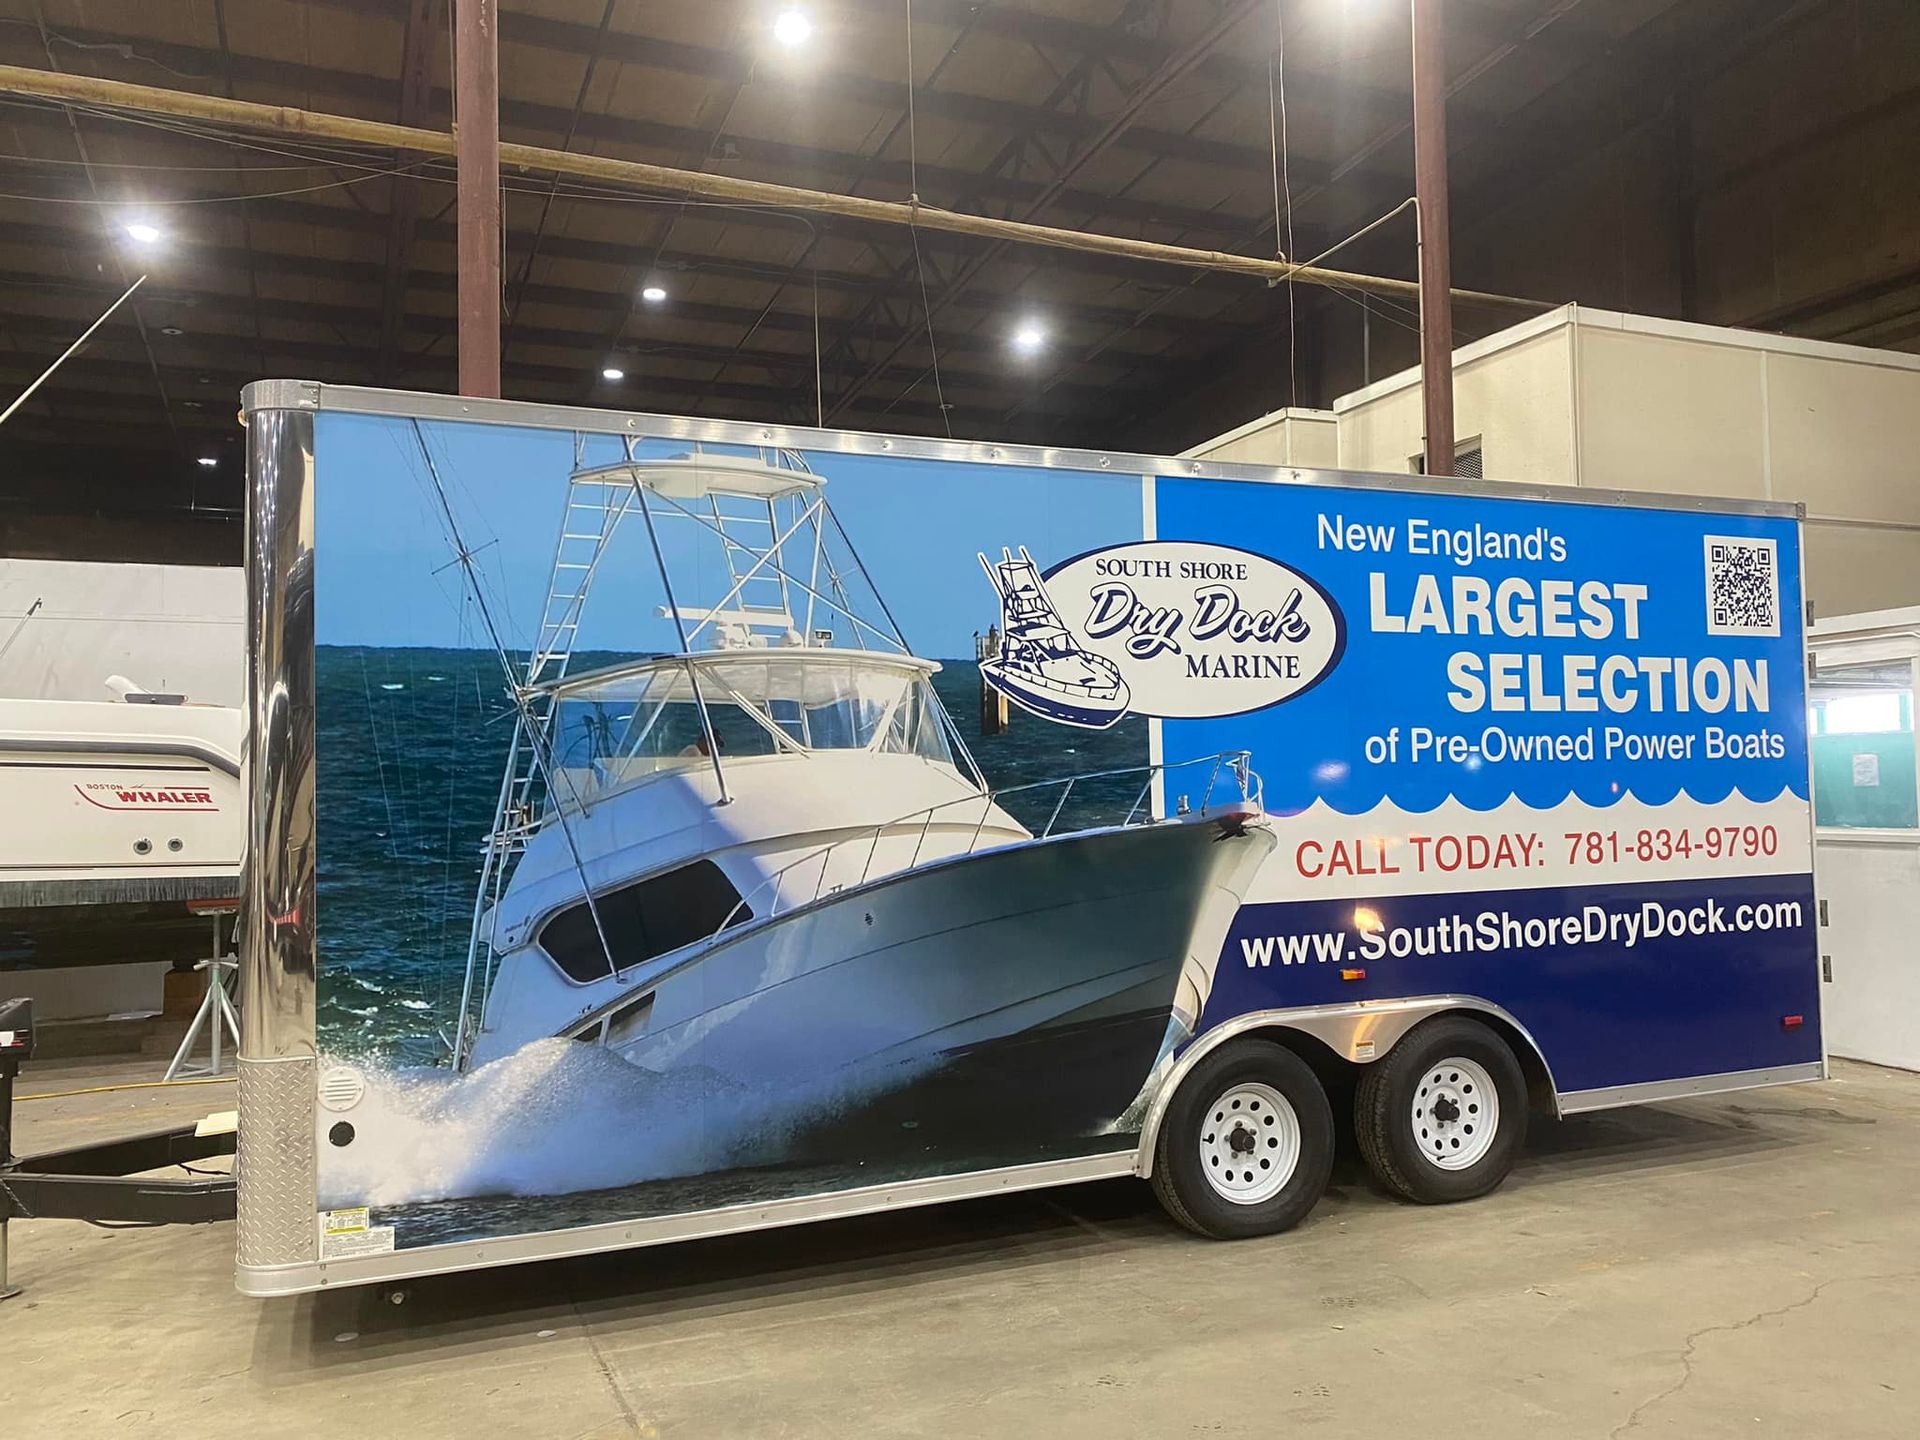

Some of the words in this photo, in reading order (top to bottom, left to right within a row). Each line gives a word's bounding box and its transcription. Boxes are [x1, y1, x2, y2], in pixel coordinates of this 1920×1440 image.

[1316, 513, 1396, 553] New
[1407, 519, 1567, 566] England's
[1095, 558, 1172, 578] SOUTH
[1179, 562, 1248, 581] SHORE
[1083, 581, 1183, 660] Dry
[1188, 583, 1312, 643] Dock
[1369, 572, 1648, 640] LARGEST
[1185, 654, 1302, 679] MARINE
[1446, 651, 1770, 714] SELECTION
[1364, 727, 1400, 764] of
[1410, 726, 1595, 764] Pre-Owned
[1604, 727, 1696, 760] Power
[1705, 727, 1786, 760] Boats
[116, 791, 213, 803] WHALER
[1295, 839, 1400, 879] CALL
[1409, 832, 1545, 872] TODAY:
[1563, 824, 1779, 865] 781-834-9790
[1240, 898, 1802, 968] www.SouthShoreDryDock.com
